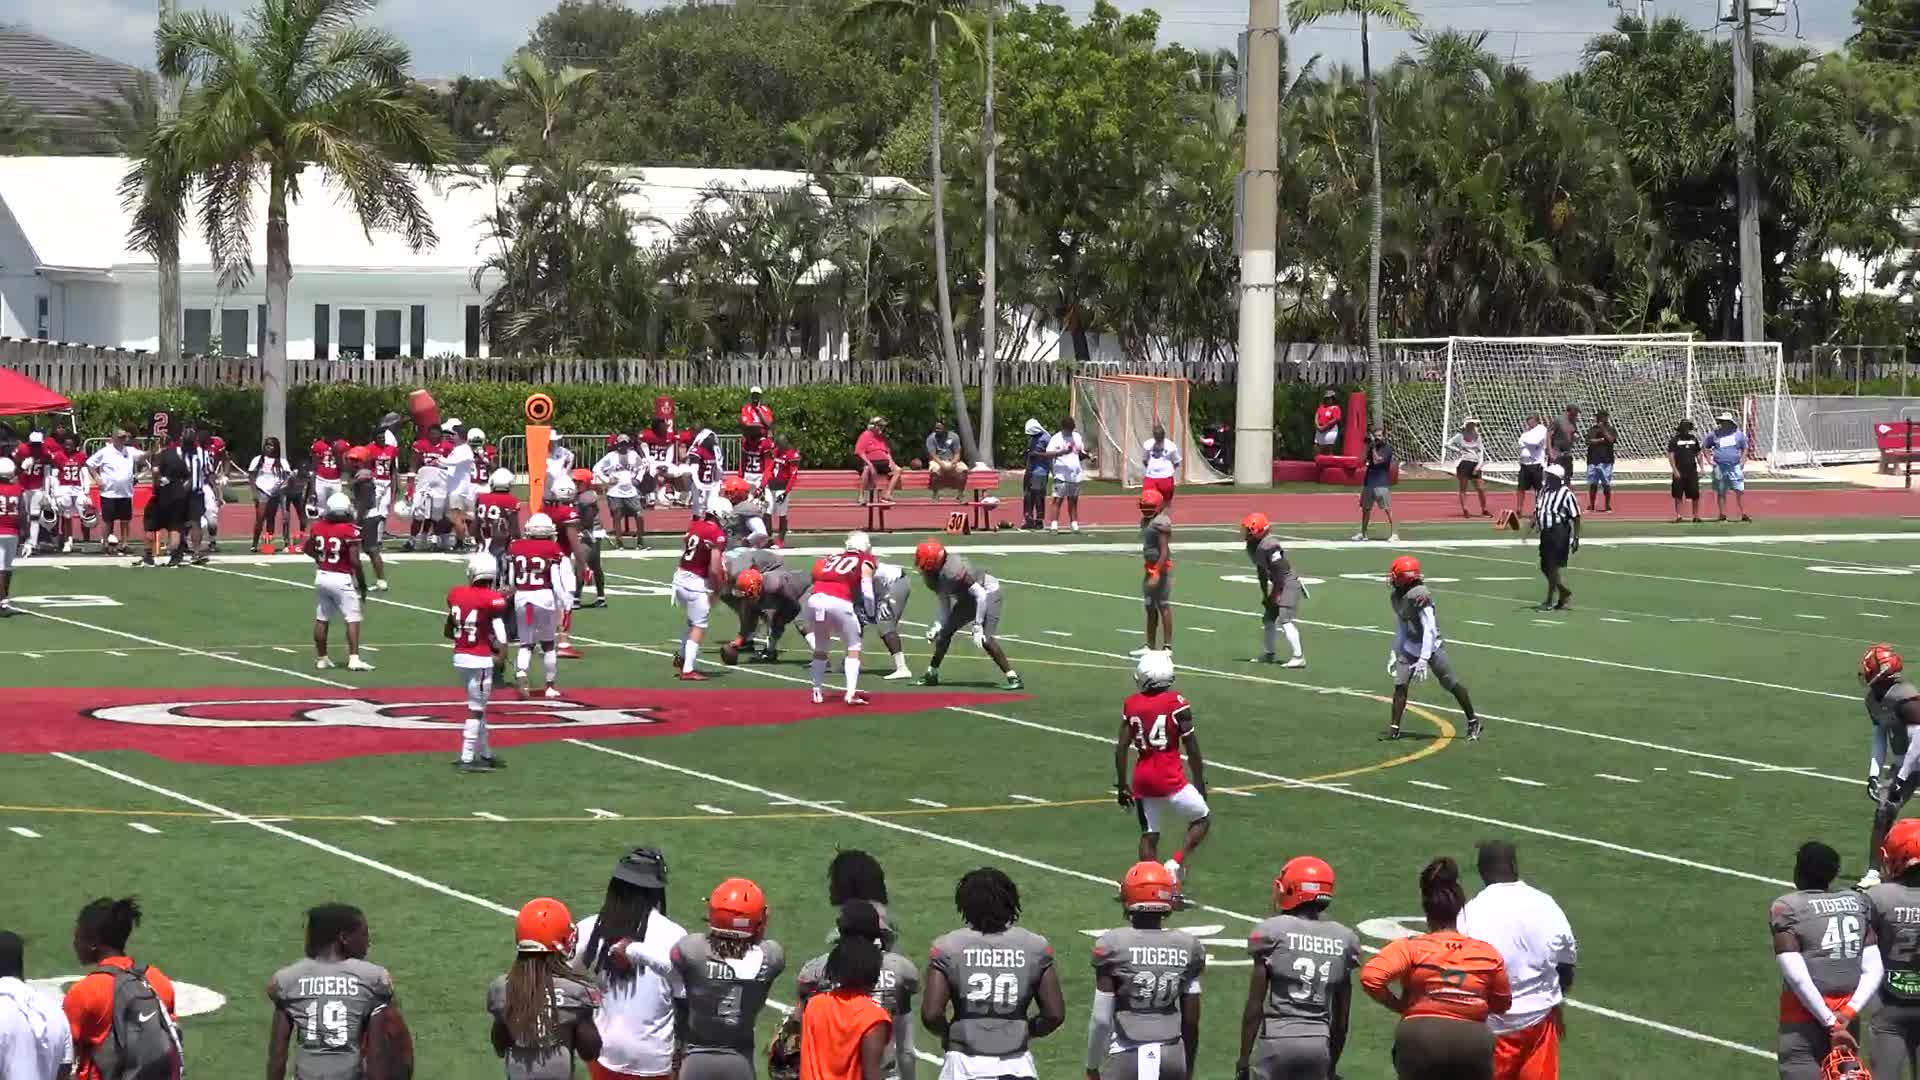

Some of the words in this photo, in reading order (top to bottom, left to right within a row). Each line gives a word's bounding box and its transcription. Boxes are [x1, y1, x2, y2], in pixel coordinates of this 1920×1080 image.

[949, 513, 963, 530] 30
[515, 555, 546, 586] 32
[1808, 896, 1860, 914] TIGERS
[1286, 932, 1345, 956] TIGERS
[1821, 916, 1860, 959] 46
[963, 948, 1025, 967] TIGERS
[1128, 946, 1188, 967] TIGERS
[298, 976, 359, 996] TIGERS
[1288, 957, 1332, 1002] 31
[966, 973, 1019, 1015] 20
[305, 999, 348, 1048] 19
